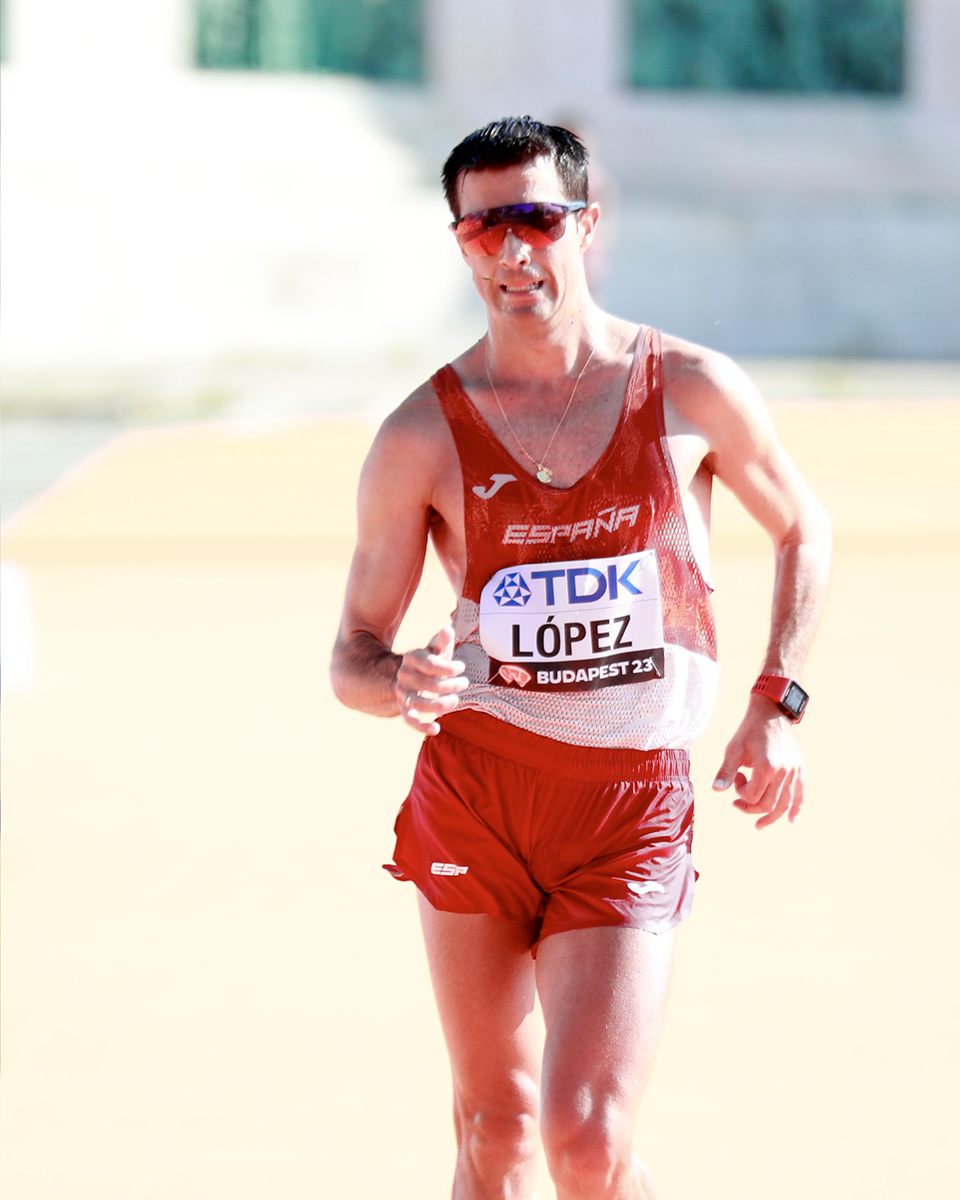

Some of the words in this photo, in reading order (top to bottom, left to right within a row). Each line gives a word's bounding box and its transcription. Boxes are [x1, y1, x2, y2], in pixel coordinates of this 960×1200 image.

[502, 504, 640, 545] ESPAÑA
[531, 560, 643, 606] TDK
[512, 615, 633, 658] LÓPEZ
[536, 662, 629, 685] BUDAPEST
[631, 656, 653, 675] 23
[430, 862, 469, 876] ESP
